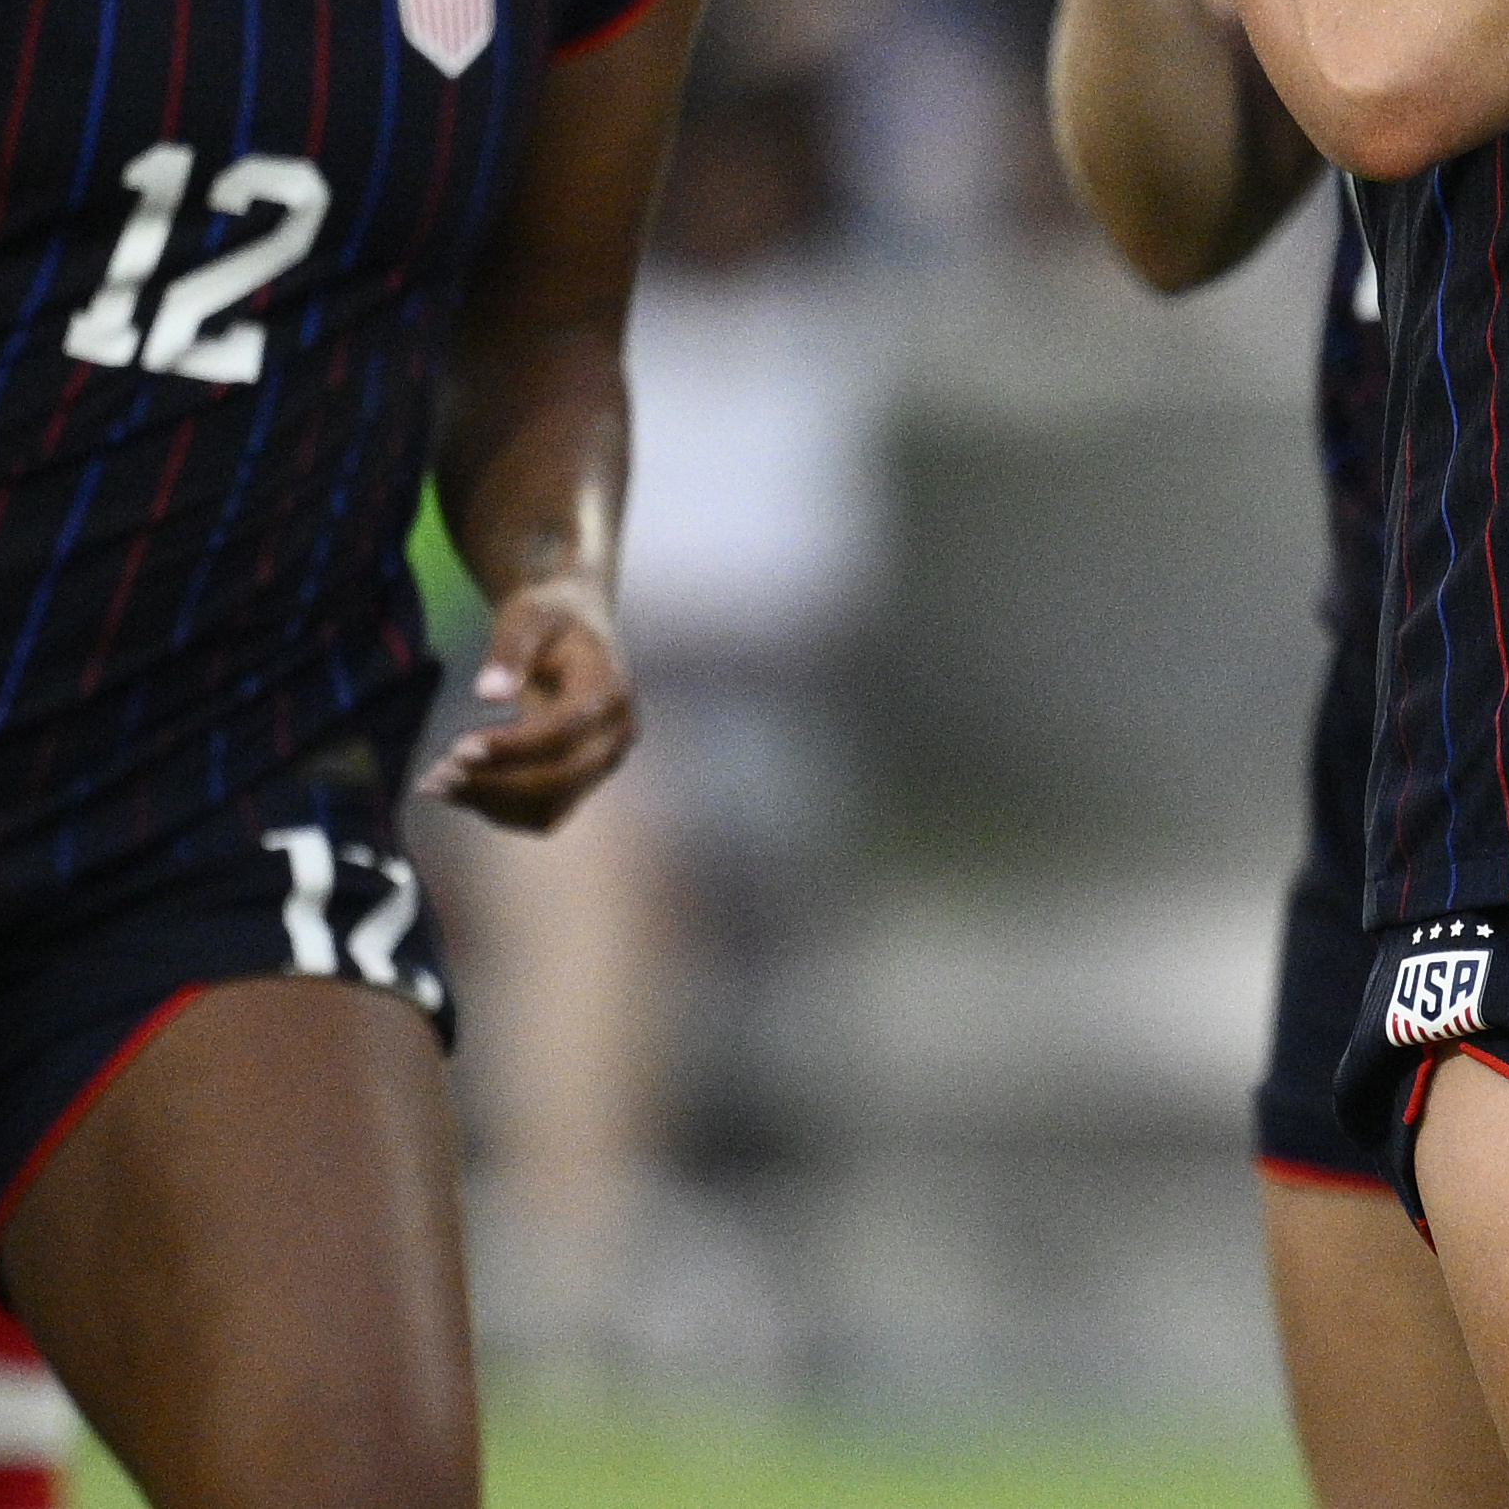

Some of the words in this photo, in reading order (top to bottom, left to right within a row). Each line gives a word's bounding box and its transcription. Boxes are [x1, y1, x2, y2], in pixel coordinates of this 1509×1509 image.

[62, 142, 332, 384] 12
[261, 824, 444, 1011] 12
[1397, 959, 1480, 1022] USA
